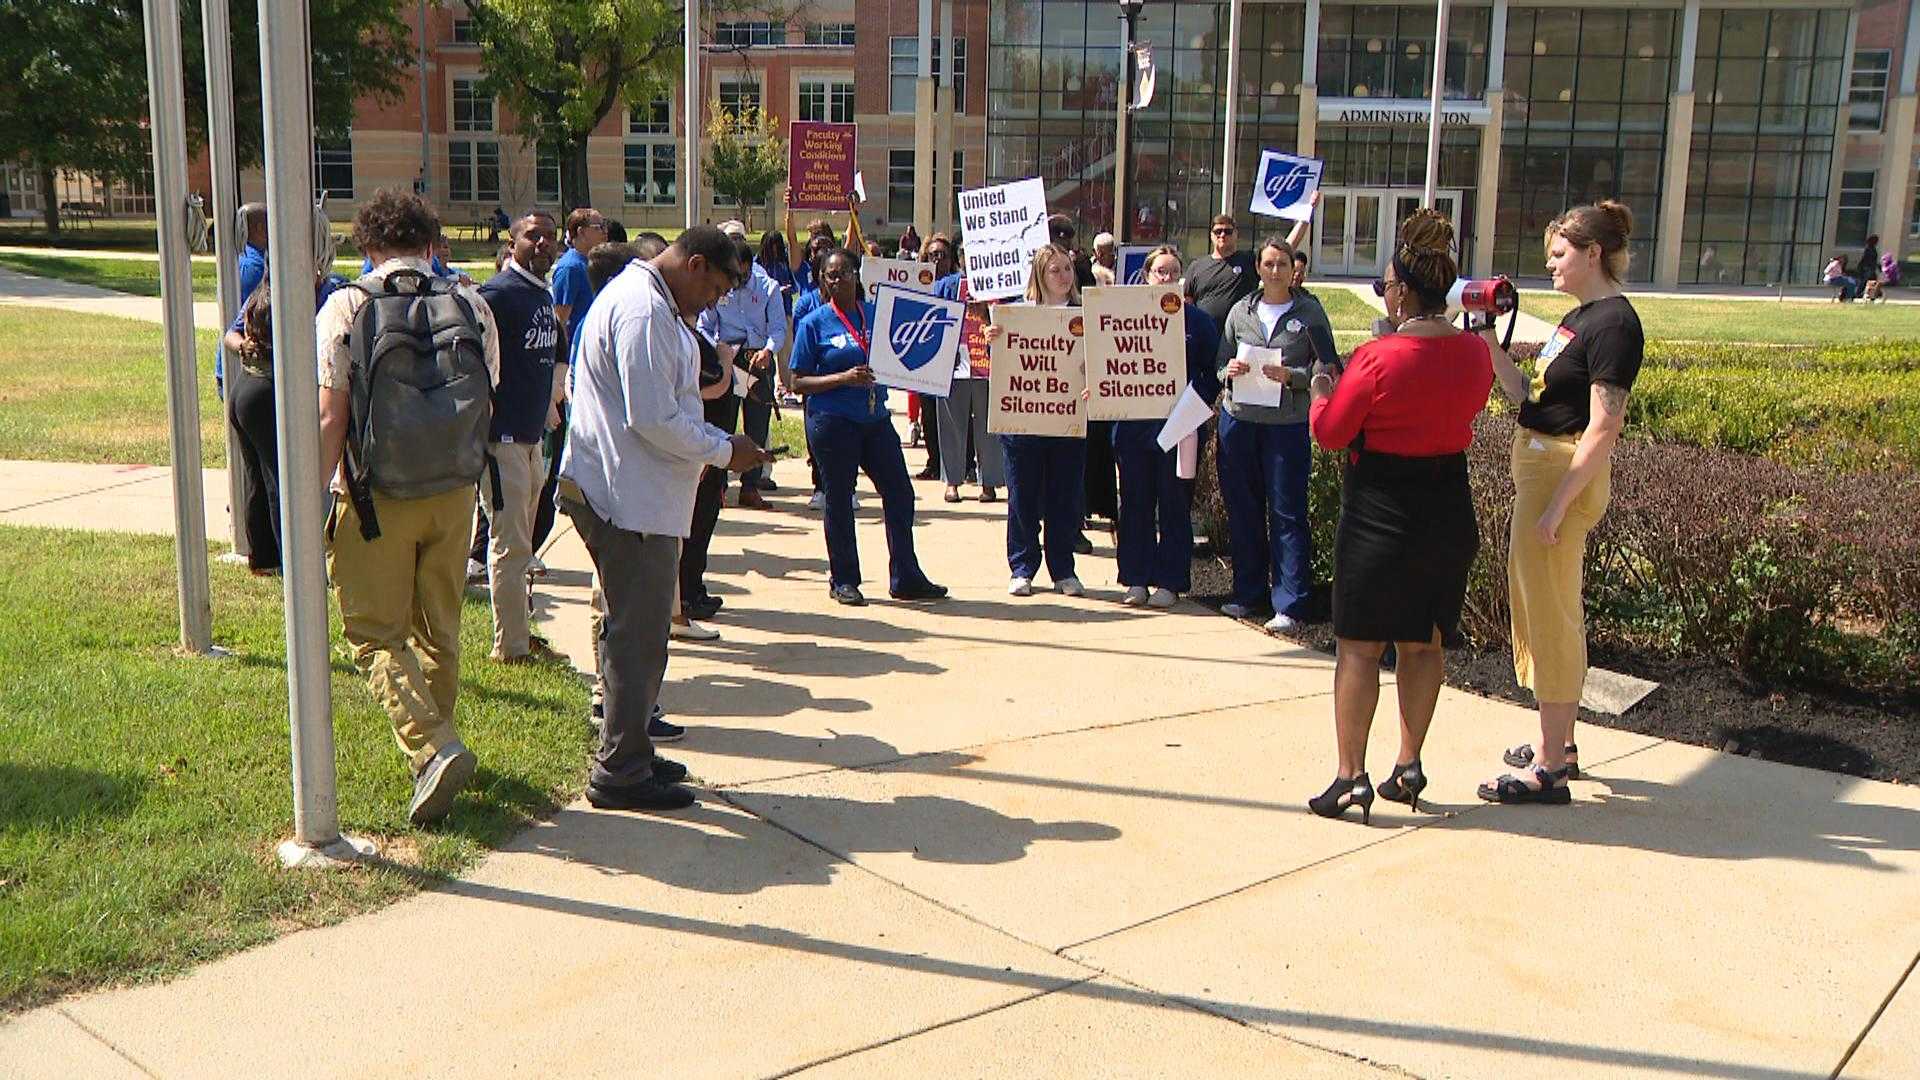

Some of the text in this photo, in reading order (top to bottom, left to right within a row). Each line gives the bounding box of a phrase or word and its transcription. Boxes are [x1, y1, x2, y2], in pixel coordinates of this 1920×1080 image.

[1339, 110, 1472, 124] ADMINISTRION
[806, 129, 840, 141] Faculty
[804, 140, 842, 152] Working
[799, 150, 846, 160] Conditions
[804, 171, 840, 181] Student
[802, 182, 842, 193] Learning
[798, 192, 847, 202] Conditions
[962, 188, 1006, 211] United
[965, 206, 1028, 231] We Stand
[970, 248, 1020, 271] Divided
[888, 268, 909, 283] NO
[972, 270, 1022, 291] We Fall
[892, 305, 959, 359] aft
[1099, 314, 1169, 334] Faculty
[1007, 333, 1076, 355] Faculty
[1114, 336, 1153, 353] Will
[1019, 354, 1058, 371] Will
[1106, 358, 1167, 375] Not Be
[1009, 376, 1069, 393] Not Be
[1099, 380, 1176, 398] Silenced
[1000, 396, 1077, 415] Silenced
